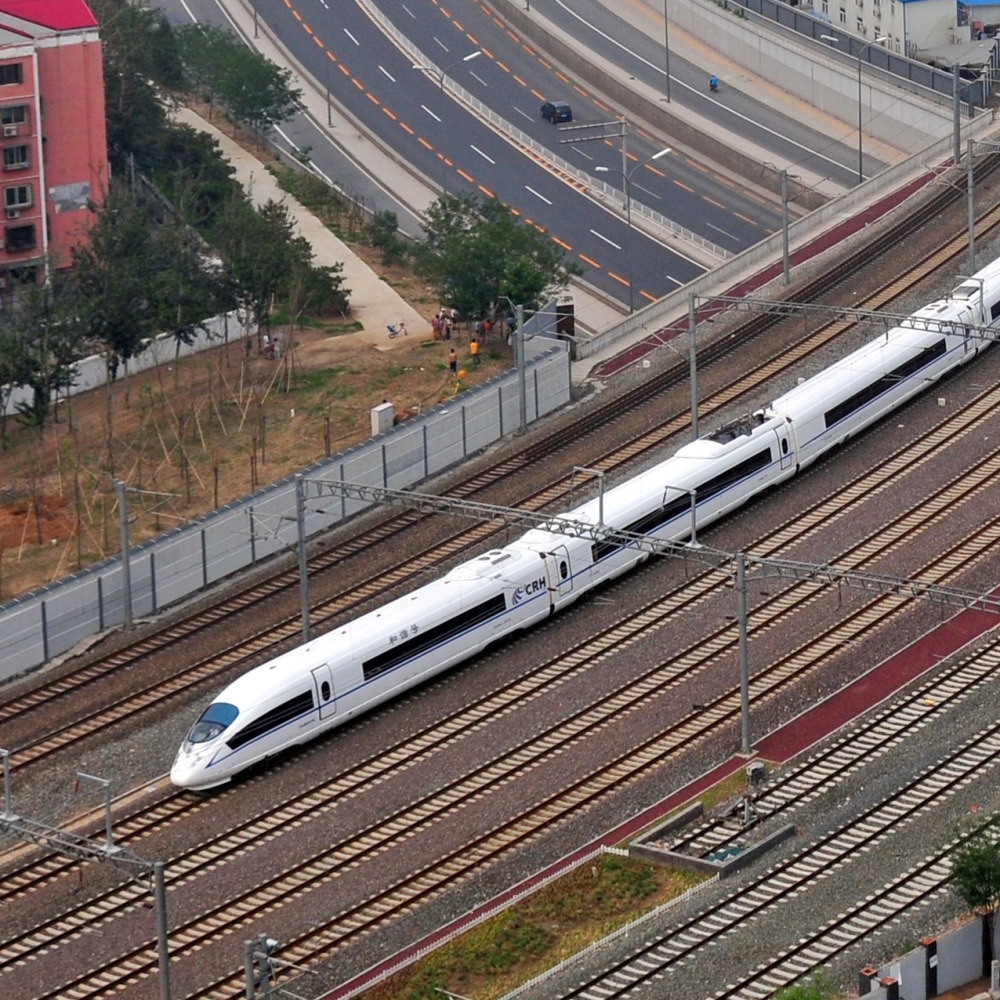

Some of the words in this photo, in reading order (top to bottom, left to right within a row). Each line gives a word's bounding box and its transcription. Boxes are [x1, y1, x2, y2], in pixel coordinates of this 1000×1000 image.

[525, 576, 546, 595] CRH
[389, 624, 419, 645] 和谐号
